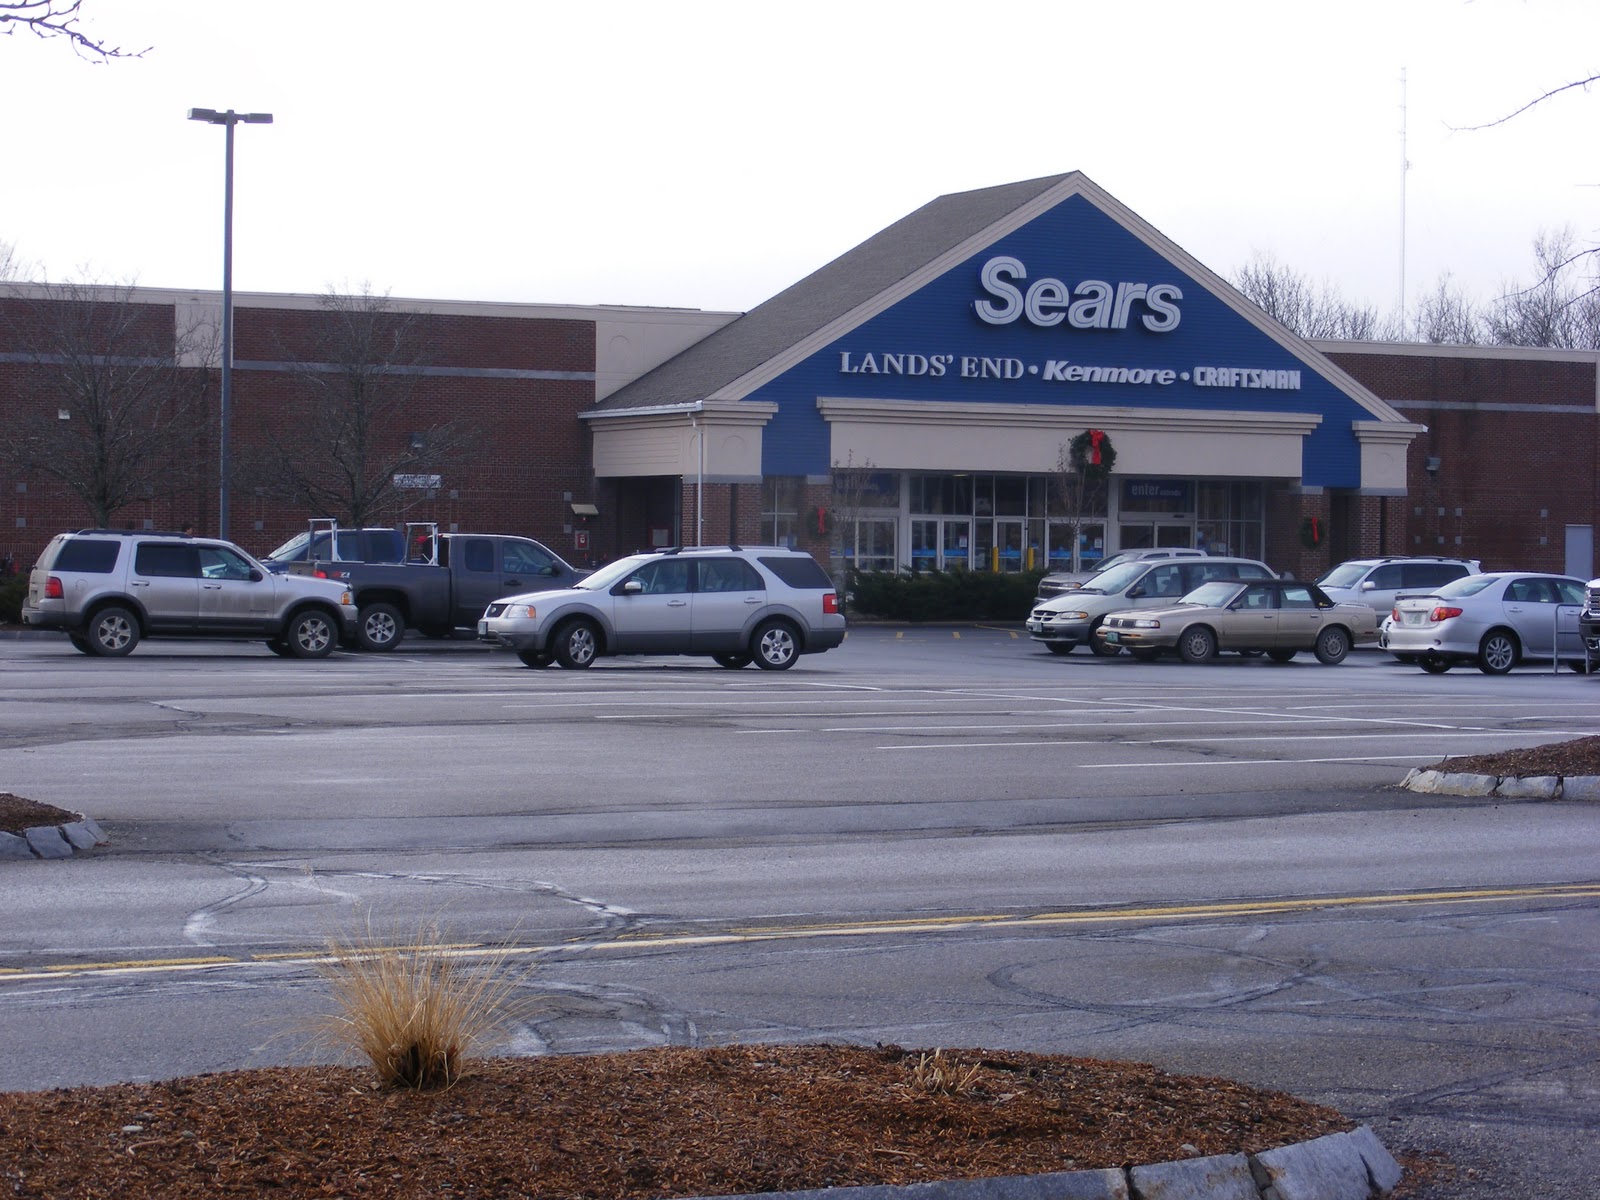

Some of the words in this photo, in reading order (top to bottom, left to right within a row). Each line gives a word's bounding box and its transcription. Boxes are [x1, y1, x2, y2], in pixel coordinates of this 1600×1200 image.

[974, 256, 1184, 333] Sears
[839, 352, 954, 377] LANDS'
[960, 356, 1025, 380] END
[1042, 360, 1176, 386] Kenmore
[1193, 366, 1301, 390] CRAFTSMAN
[1131, 484, 1160, 496] enter
